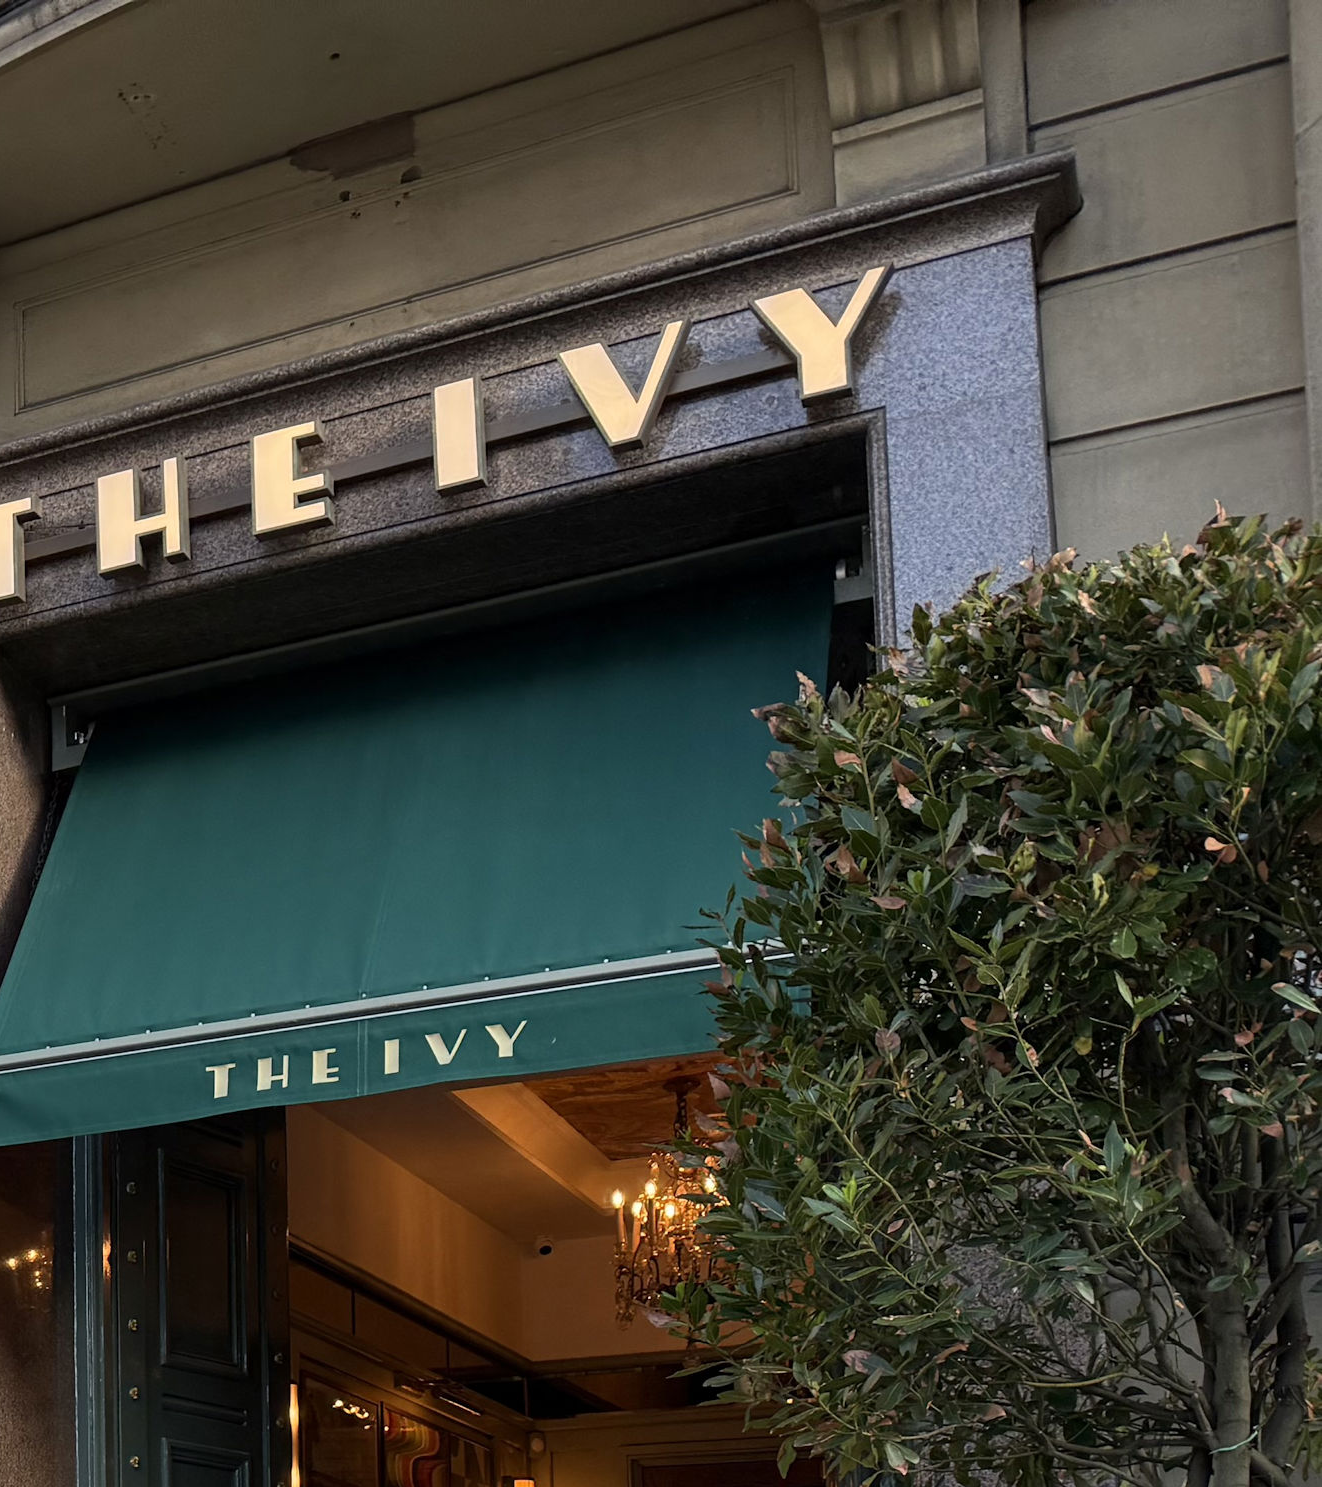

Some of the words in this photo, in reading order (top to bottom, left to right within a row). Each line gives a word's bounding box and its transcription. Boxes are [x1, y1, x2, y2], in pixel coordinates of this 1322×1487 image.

[432, 263, 895, 497] IVY
[205, 1048, 340, 1099] THE
[384, 1020, 528, 1075] IVY
